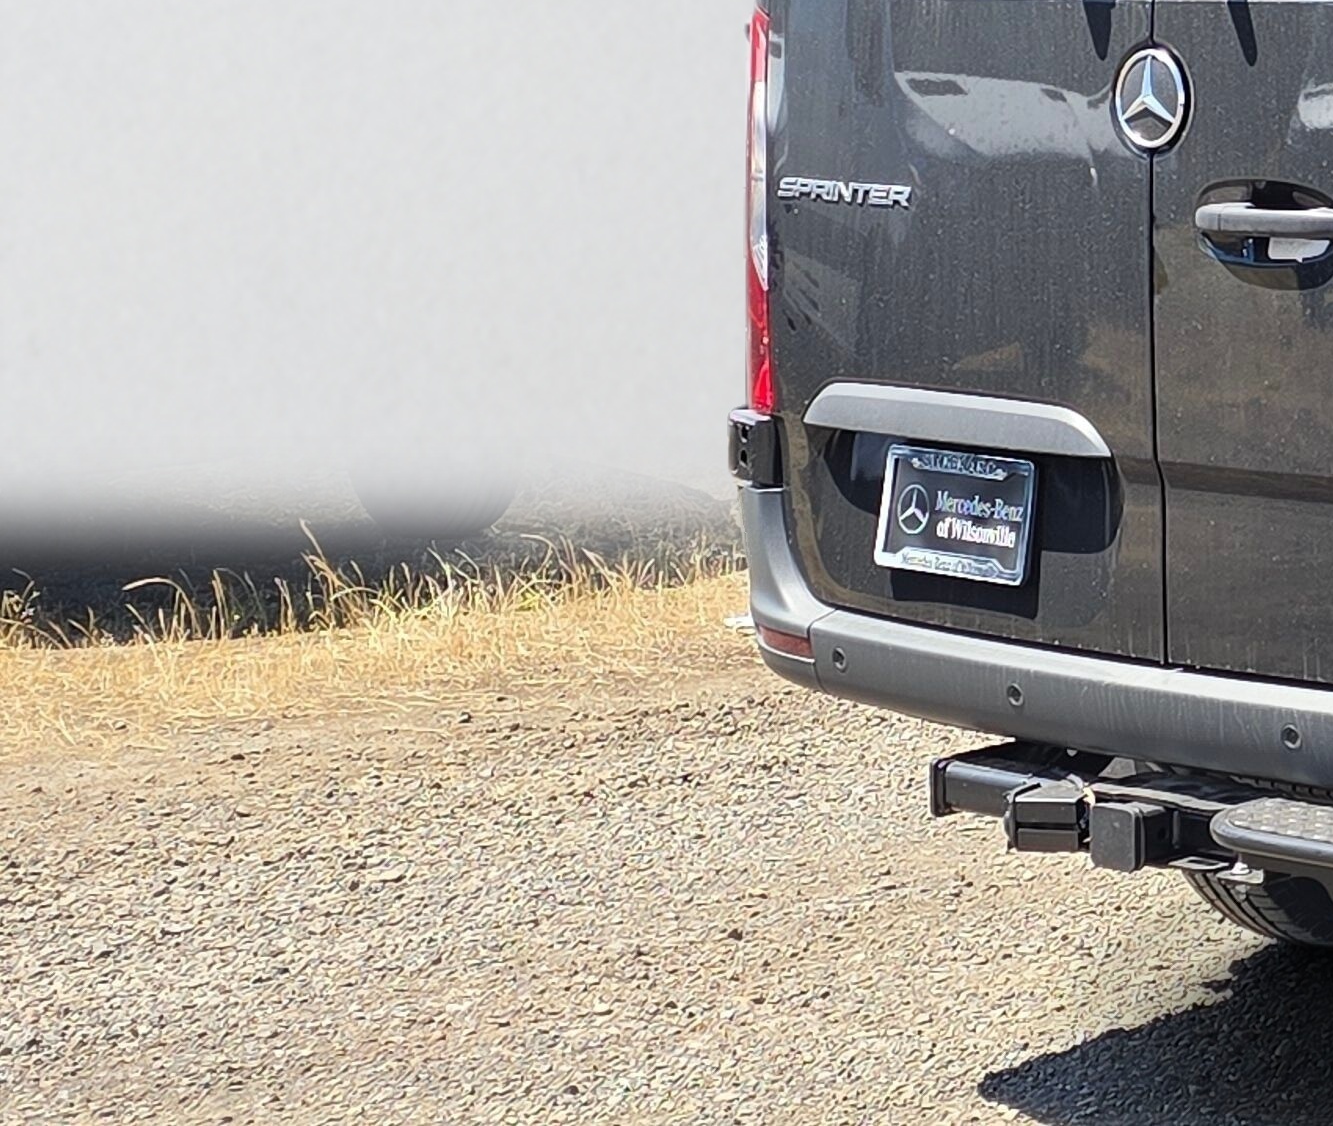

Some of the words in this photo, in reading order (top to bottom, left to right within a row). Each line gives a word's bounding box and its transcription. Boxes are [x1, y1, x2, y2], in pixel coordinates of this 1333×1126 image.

[777, 176, 912, 207] SPRINTER
[934, 490, 1024, 522] Mercedes-Benz
[935, 517, 951, 540] of
[951, 519, 1017, 548] Wilsonville
